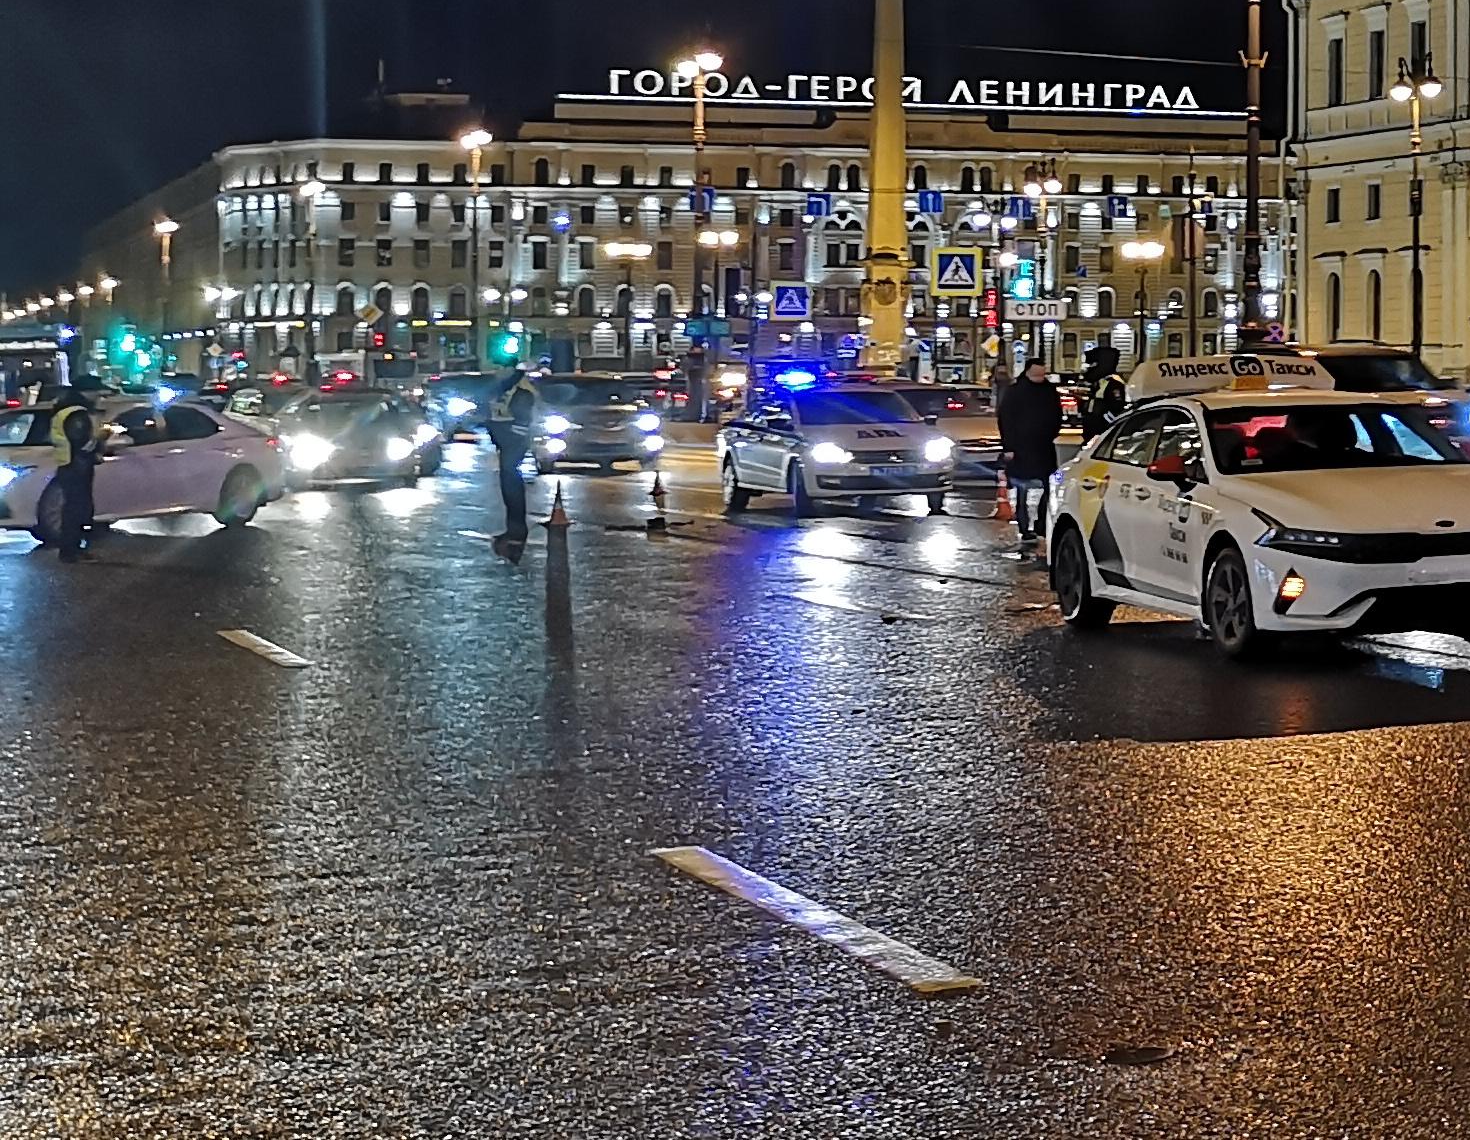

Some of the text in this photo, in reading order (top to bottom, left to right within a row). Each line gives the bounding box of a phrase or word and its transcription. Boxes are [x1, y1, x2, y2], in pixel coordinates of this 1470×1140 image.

[948, 80, 1200, 109] ЛЕНИНГРАД
[1015, 303, 1058, 316] СТОП
[1158, 359, 1316, 378] Яндекс Go Такси
